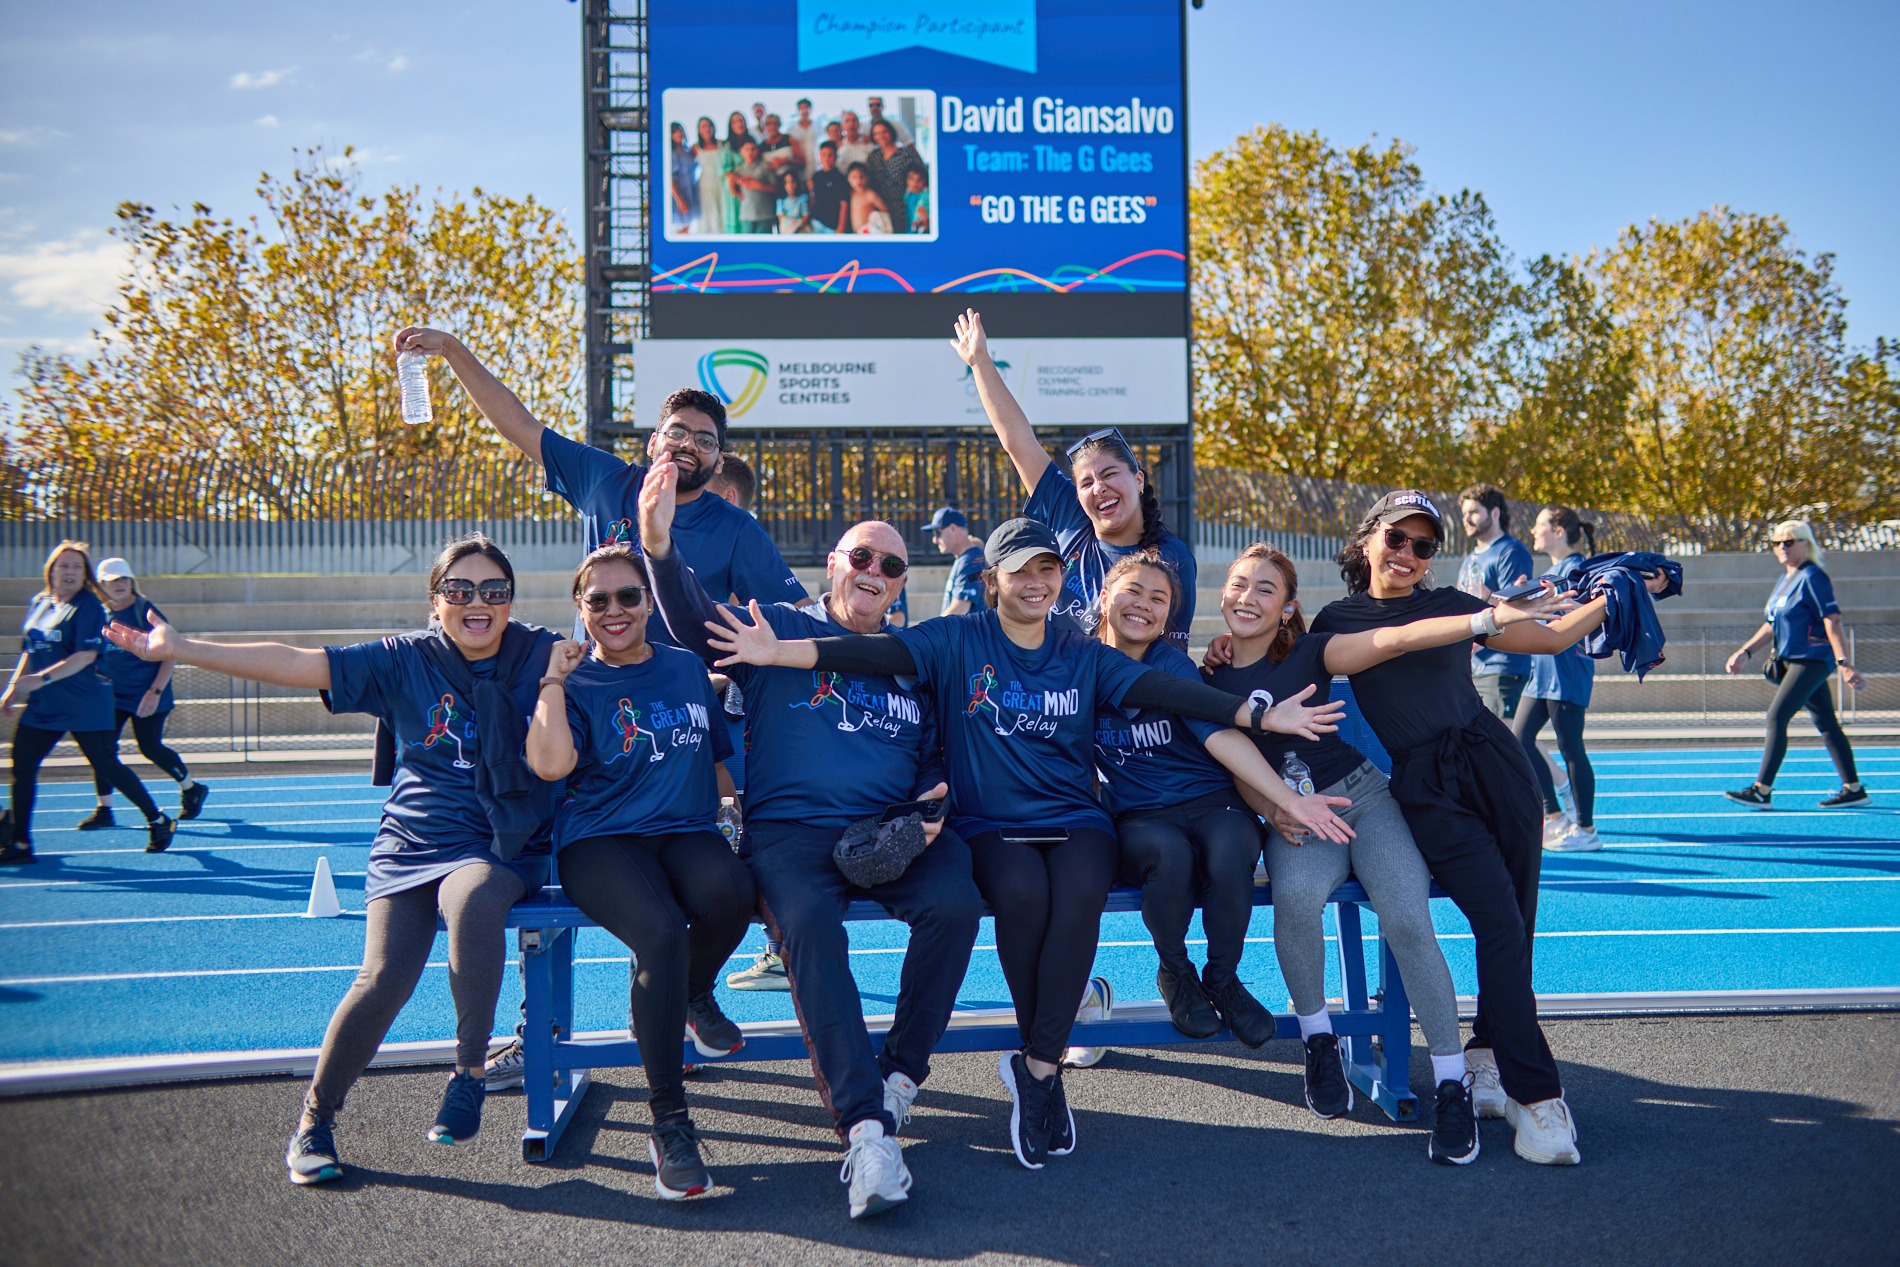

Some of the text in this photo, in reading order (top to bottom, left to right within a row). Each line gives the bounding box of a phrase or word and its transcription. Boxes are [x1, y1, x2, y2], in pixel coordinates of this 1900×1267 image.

[813, 12, 1025, 40] Champion Participant
[941, 96, 1174, 134] David Giansalvo
[963, 144, 1154, 172] Team: The G Gees
[1019, 195, 1064, 223] THE
[1068, 195, 1085, 223] G
[779, 362, 876, 374] MELBOURNE
[1037, 365, 1103, 375] RECOGNISED
[779, 377, 840, 389] SPORTS
[1037, 377, 1081, 386] OLYMPIC
[1038, 387, 1127, 396] TRAINING CENTRE
[779, 392, 850, 404] CENTRES
[1069, 599, 1100, 631] Relay
[850, 681, 865, 692] THE
[1010, 681, 1023, 691] THE
[650, 701, 667, 712] THE
[847, 688, 920, 724] GREAT MND
[1002, 688, 1079, 716] GREAT MND
[650, 707, 689, 729] GREAT
[864, 711, 901, 737] Relay
[1017, 713, 1058, 739] Relay
[672, 726, 702, 752] Relay
[1131, 719, 1172, 748] MND
